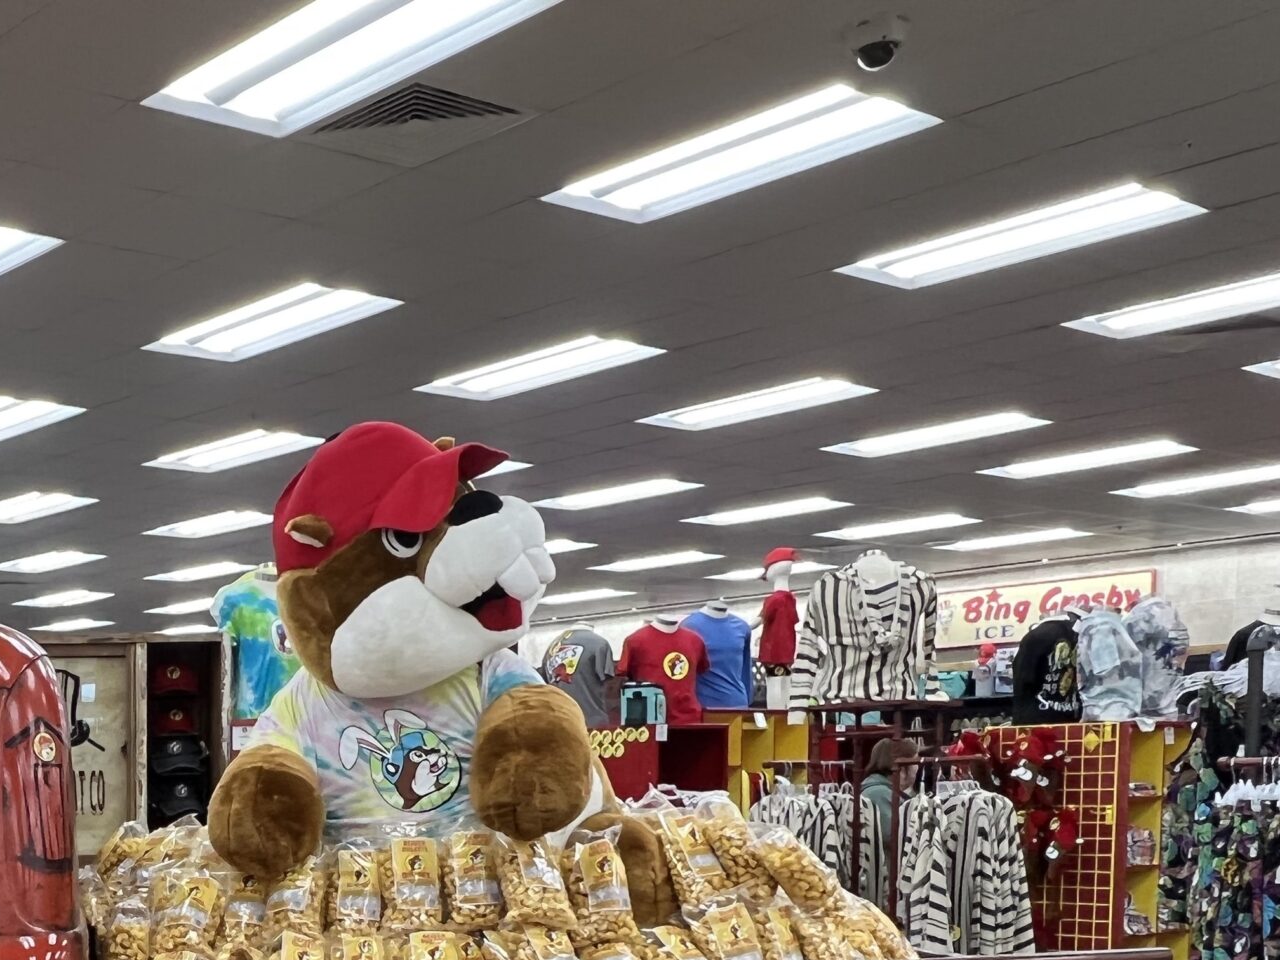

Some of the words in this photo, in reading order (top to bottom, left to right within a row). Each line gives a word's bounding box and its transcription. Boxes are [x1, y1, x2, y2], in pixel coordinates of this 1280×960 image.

[962, 590, 1032, 624] Bing
[1039, 584, 1141, 614] Crosby
[974, 624, 1015, 641] ICE
[89, 769, 106, 815] CO
